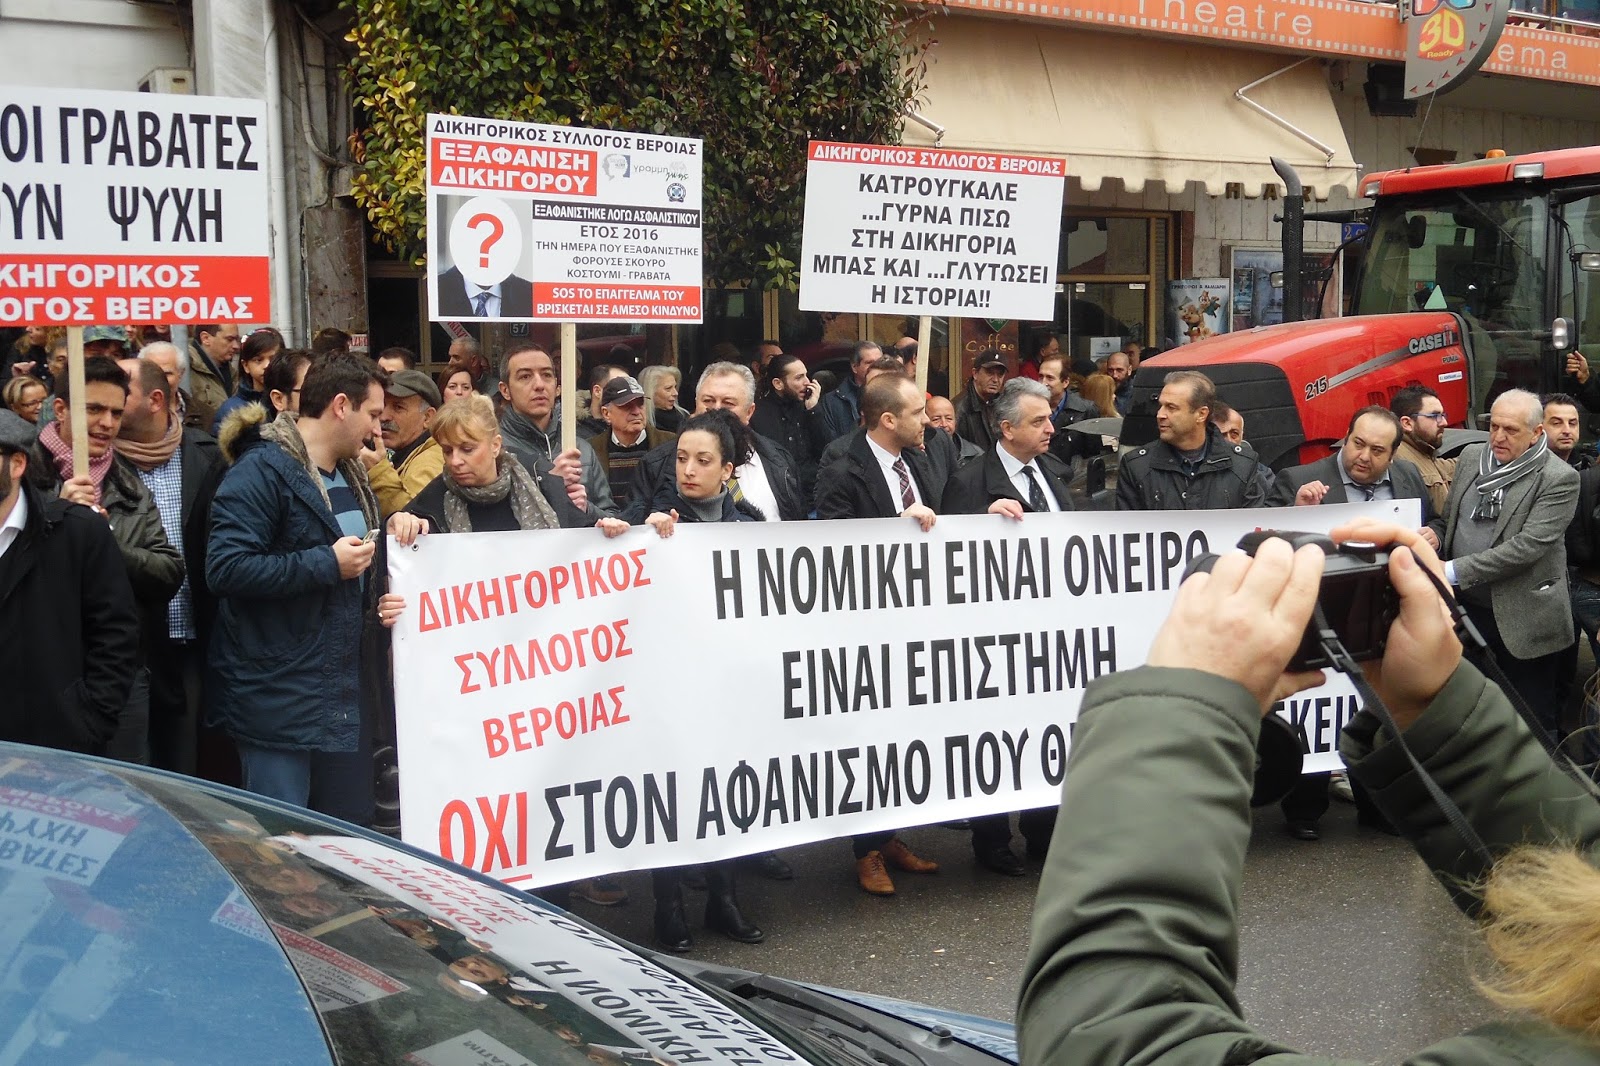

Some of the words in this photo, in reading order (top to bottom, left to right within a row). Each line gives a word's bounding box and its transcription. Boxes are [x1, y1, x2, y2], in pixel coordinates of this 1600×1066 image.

[1419, 8, 1465, 52] 3D
[1427, 50, 1454, 59] Ready
[1, 104, 43, 163] ΟΙ
[59, 107, 259, 171] ΓΡΑΒΑΤΕΣ
[434, 120, 547, 142] ΔΙΚΗΓΟΡΙΚΟΣ
[552, 130, 631, 150] ΣΥΛΛΟΓΟΣ
[636, 139, 697, 155] ΒΕΡΟΙΑΣ
[439, 142, 589, 171] ΕΞΑΦΑΝΙΣΗ
[814, 144, 915, 164] ΔΙΚΗΓΟΡΙΚΟΣ
[920, 151, 996, 169] ΣΥΛΛΟΓΟΣ
[1000, 158, 1061, 174] ΒΕΡΟΙΑΣ
[438, 166, 589, 193] ΔΙΚΗΓΟΡΟΥ
[859, 173, 1018, 201] ΚΑΤΡΟΥΓΚΑΛΕ
[0, 183, 63, 240] ΥΝ
[107, 185, 223, 242] ΨΥΧΗ
[534, 204, 606, 219] ΕΞΑΦΑΝΙΣΤΗΚΕ
[607, 208, 633, 221] ΛΟΓΩ
[633, 210, 698, 225] ΑΣΦΑΛΙΣΤΙΚΟΥ
[862, 203, 952, 225] ...ΓΥΡΝΑ
[960, 208, 1010, 228] ΠΙΣΩ
[580, 226, 619, 239] ΕΤΟΣ
[623, 228, 659, 241] 2016
[851, 229, 894, 249] ΣΤΗ
[901, 232, 1017, 256] ΔΙΚΗΓΟΡΙΑ
[536, 241, 558, 251] ΤΗΝ
[561, 243, 597, 252] ΗΜΕΡΑ
[600, 244, 621, 253] ΠΟΥ
[623, 245, 699, 256] ΕΞΑΦΑΝΙΣΤΗΚΕ
[572, 256, 623, 267] ΦΟΡΟΥΣΕ
[625, 258, 666, 268] ΣΚΟΥΡΟ
[567, 270, 621, 279] ΚΟΣΤΟΥΜΙ
[629, 272, 671, 281] ΓΡΑΒΑΤΑ
[813, 255, 876, 276] ΜΠΑΣ
[883, 258, 920, 278] ΚΑΙ
[928, 261, 1048, 284] ...ΓΛΥΤΩΣΕΙ
[106, 296, 253, 320] ΒΕΡΟΙΑΣ
[552, 288, 575, 298] SOS
[577, 288, 593, 299] ΤΟ
[595, 288, 660, 300] ΕΠΑΓΓΕΛΜΑ
[662, 290, 685, 301] ΤΟΥ
[872, 285, 885, 303] Η
[894, 286, 991, 308] ΙΣΤΟΡΙΑ!!
[537, 303, 593, 315] ΒΡΙΣΚΕΤΑΙ
[595, 304, 609, 315] ΣΕ
[612, 304, 649, 315] ΑΜΕΣΟ
[651, 305, 699, 316] ΚΙΝΔΥΝΟ
[512, 323, 527, 334] 57
[965, 333, 1014, 352] Coffee
[1305, 376, 1328, 401] 215
[418, 549, 651, 633] ΔΙΚΗΓΟΡΙΚΟΣ
[712, 549, 744, 620] Η
[757, 541, 931, 617] ΝΟΜΙΚΗ
[945, 537, 1052, 604] ΕΙΝΑΙ
[454, 619, 633, 694] ΣΥΛΛΟΓΟΣ
[782, 644, 891, 720] ΕΙΝΑΙ
[907, 626, 1117, 707] ΕΠΙΣΤΗΜΗ
[483, 685, 630, 758] ΒΕΡΟΙΑΣ
[438, 791, 528, 872] ΟΧΙ
[544, 771, 678, 861] ΣΤΟΝ
[695, 737, 931, 840] ΑΦΑΝΙΣΜΟ
[945, 728, 1029, 801] ΠΟΥ
